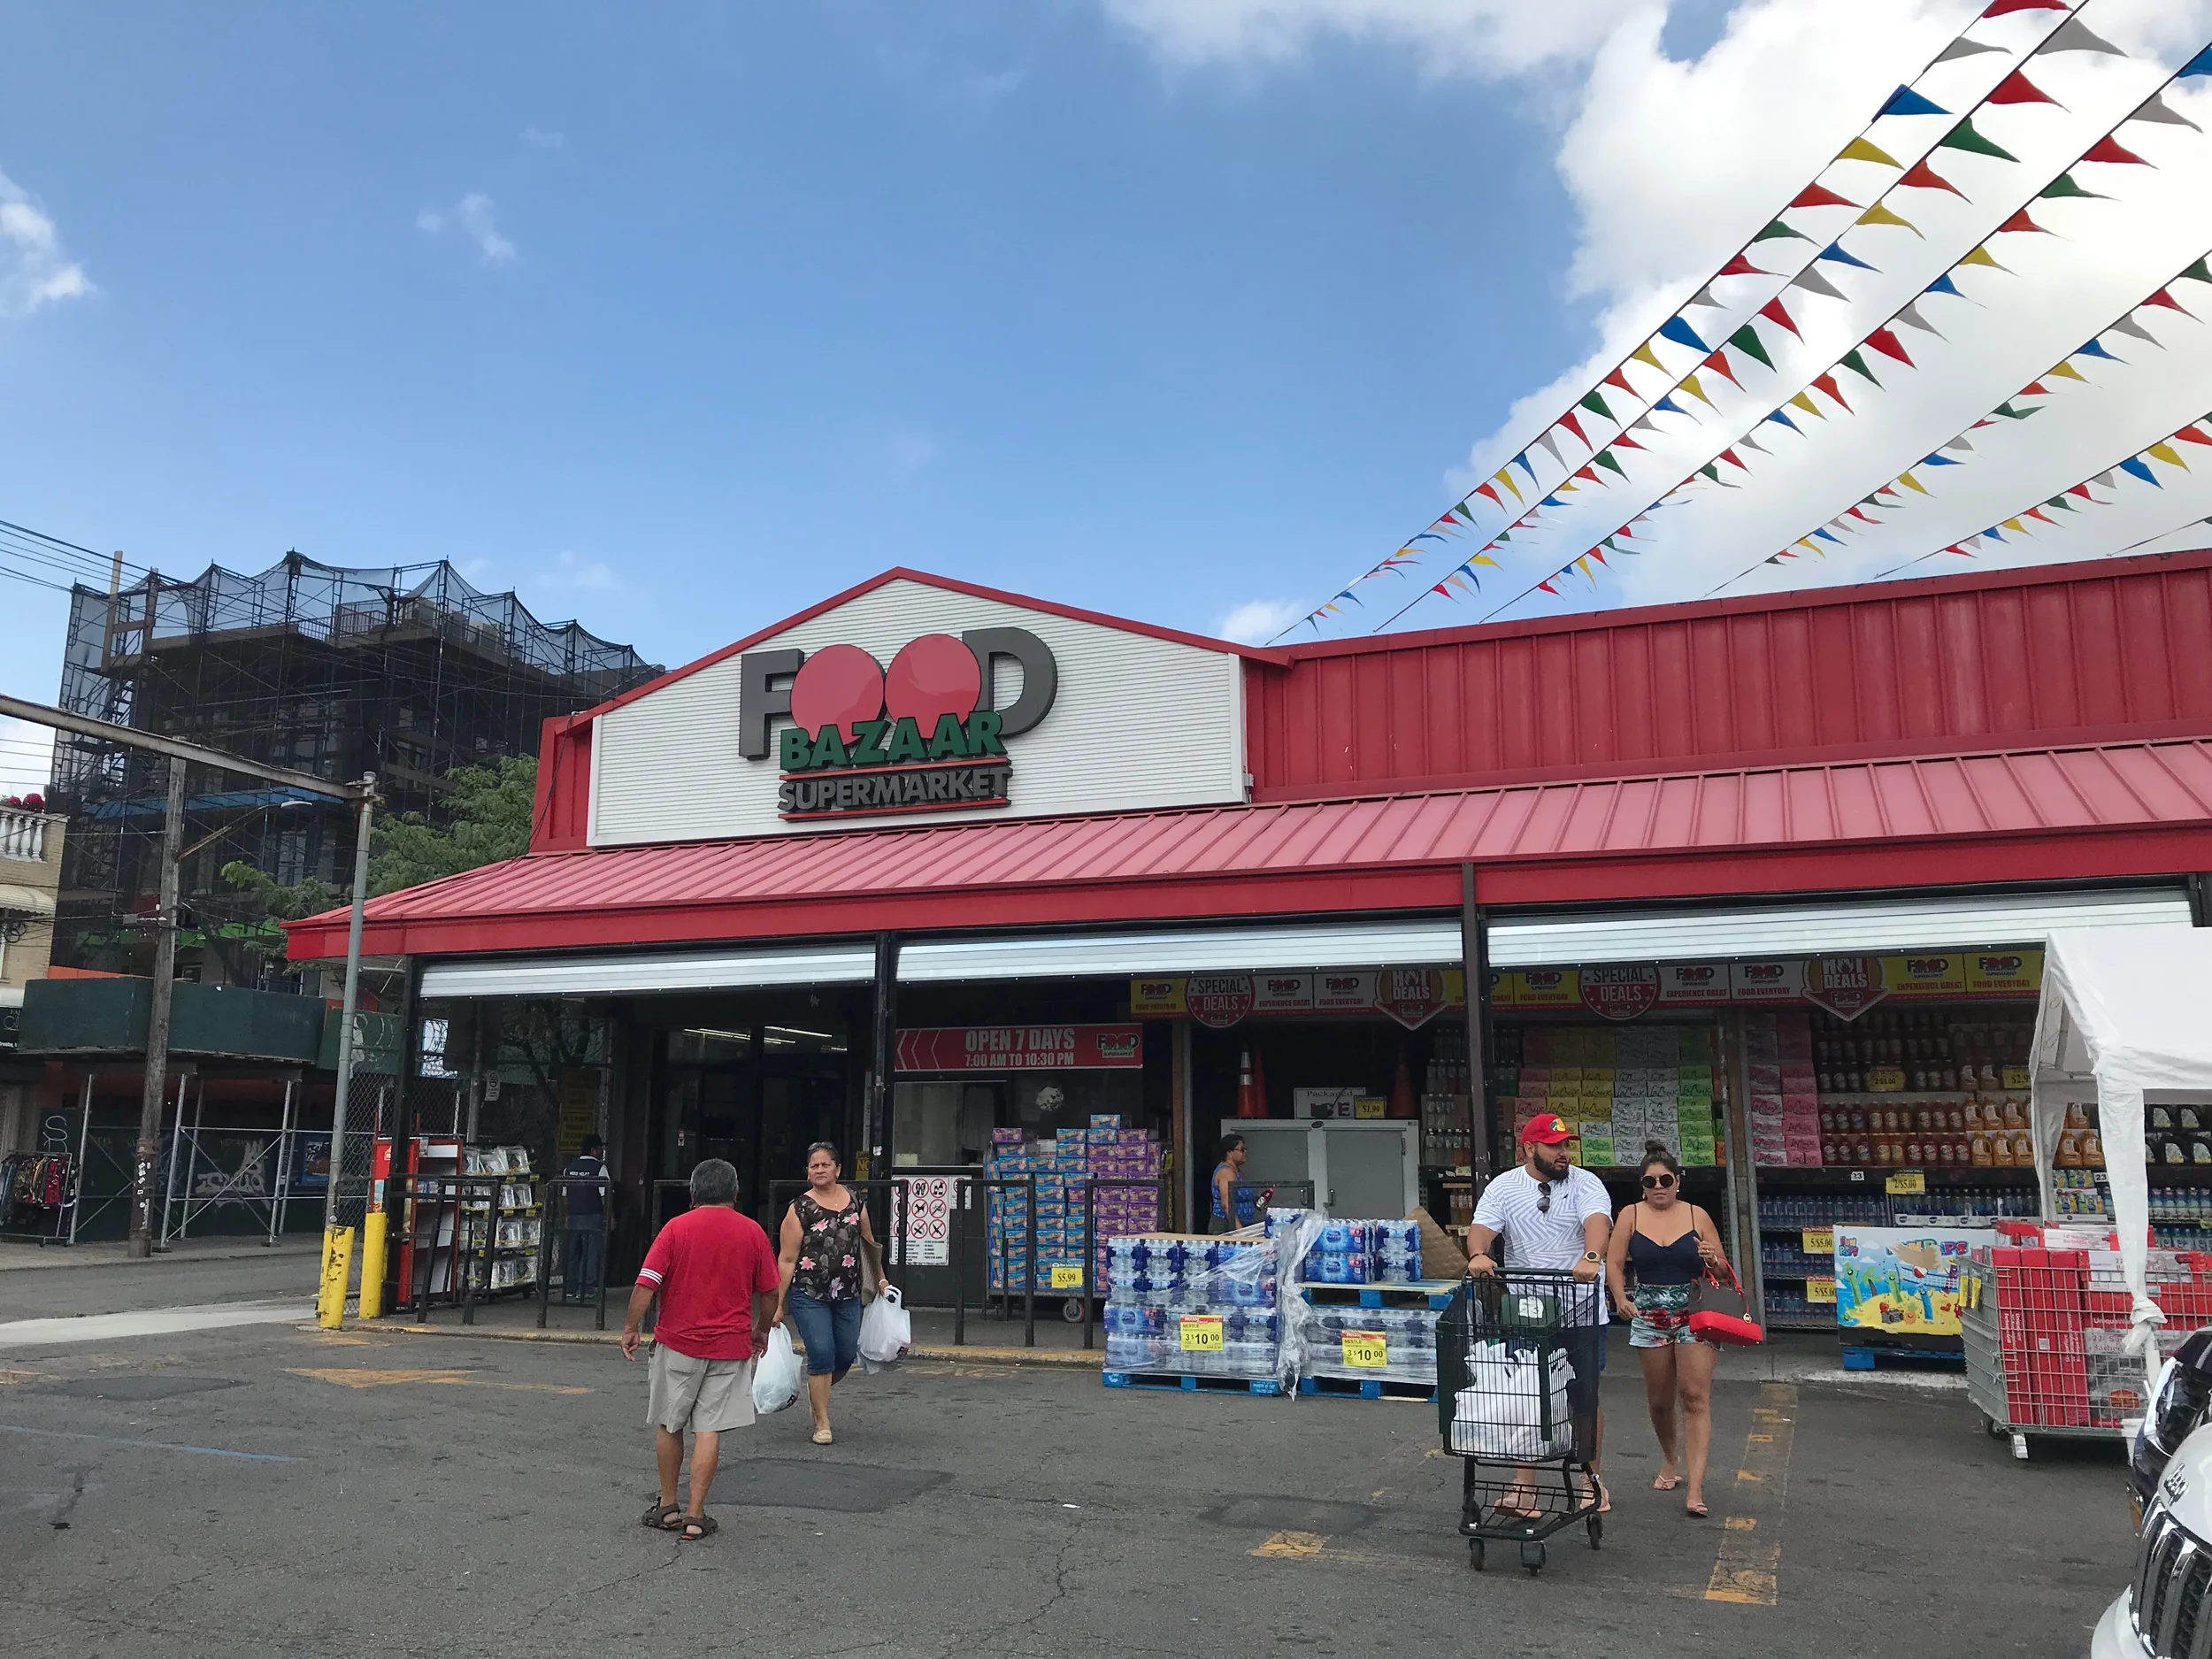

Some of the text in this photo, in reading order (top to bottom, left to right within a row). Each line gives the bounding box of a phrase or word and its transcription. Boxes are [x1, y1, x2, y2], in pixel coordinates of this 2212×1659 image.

[739, 626, 1057, 761] FOOD
[780, 710, 1008, 771] BAZAAR
[777, 766, 1013, 812] SUPERMARKET
[1594, 968, 1647, 983] SPECIAL
[1824, 973, 1868, 988] DEALS
[1198, 979, 1243, 994] SPECIAL
[1394, 986, 1431, 1000] DEALS
[1601, 986, 1641, 1002] DEALS
[1203, 995, 1239, 1011] DEALS
[965, 1028, 1075, 1052] OPEN 7 DAYS
[1097, 1033, 1140, 1049] FOOD
[965, 1052, 1074, 1067] 7:00 AM TO 10:30 PM
[1810, 1238, 1832, 1248] 5/$5.00
[1839, 1246, 1859, 1256] POPS
[1057, 1273, 1076, 1282] $5.99
